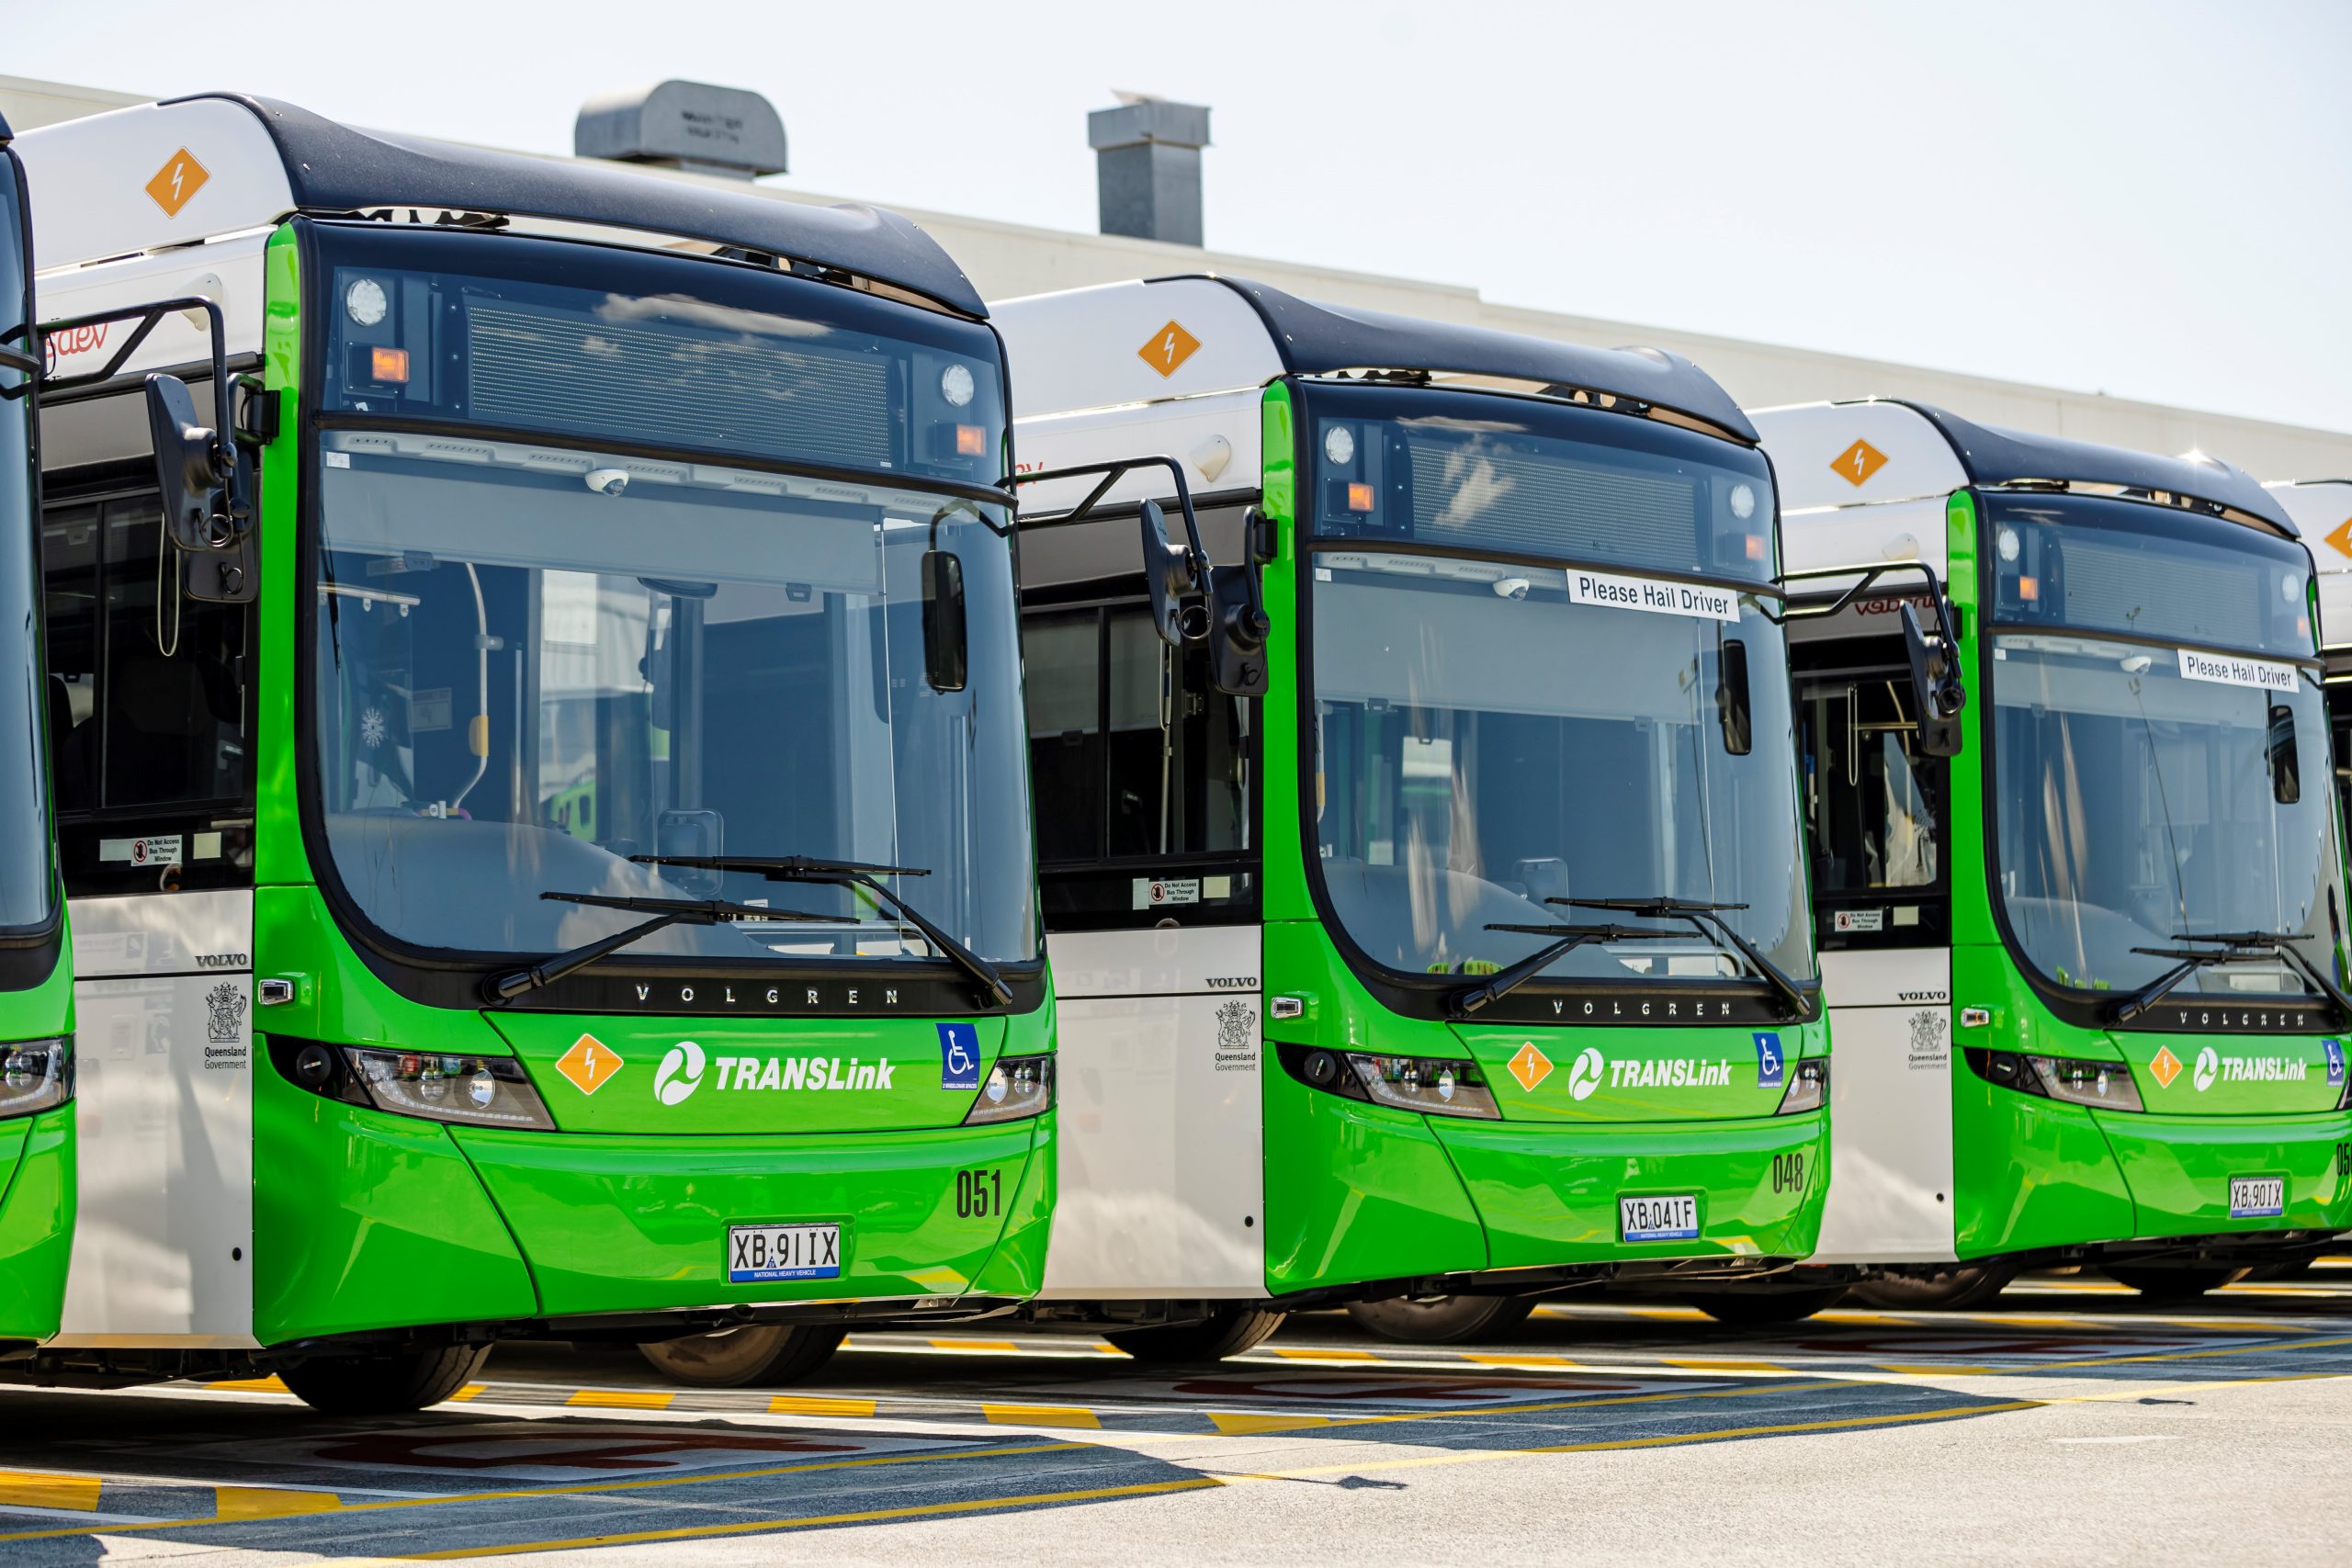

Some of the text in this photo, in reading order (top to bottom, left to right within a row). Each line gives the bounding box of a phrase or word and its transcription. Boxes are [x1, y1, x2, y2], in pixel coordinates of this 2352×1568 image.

[1579, 576, 1728, 615] Please Hail Driver
[2187, 656, 2291, 686] Please Hail Driver
[195, 953, 247, 967] VOLVO
[1205, 977, 1257, 987] VOLVO
[636, 986, 898, 1004] VOLGREN
[1898, 991, 1946, 1000] VOLVO
[1553, 1001, 1730, 1016] VOLGREN
[205, 1046, 246, 1056] Queensland
[1215, 1053, 1256, 1061] Queensland
[1908, 1054, 1947, 1062] Queensland
[205, 1059, 246, 1069] Government
[1215, 1063, 1256, 1071] Government
[2222, 1057, 2308, 1081] TRANSLink
[715, 1057, 897, 1090] TRANSLink
[1610, 1059, 1733, 1088] TRANSLink
[2336, 1143, 2352, 1177] 05
[1773, 1153, 1804, 1194] 048
[956, 1169, 1001, 1218] 051
